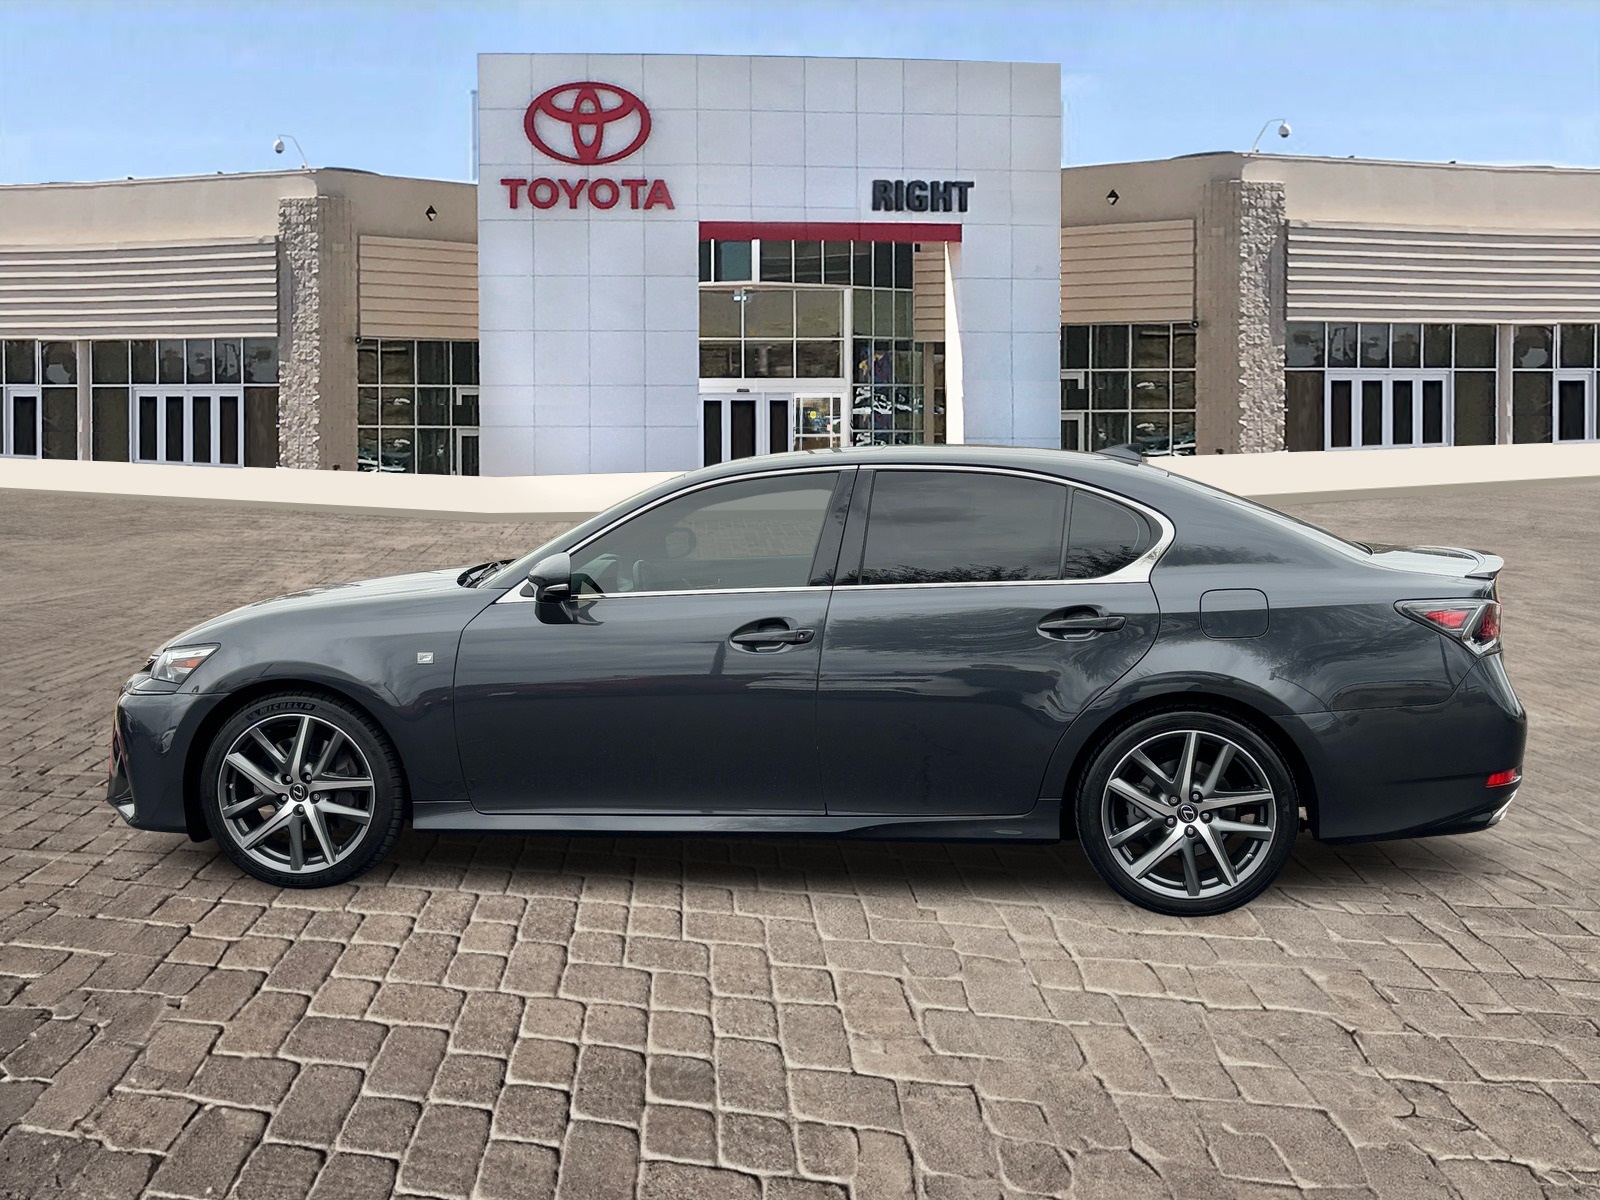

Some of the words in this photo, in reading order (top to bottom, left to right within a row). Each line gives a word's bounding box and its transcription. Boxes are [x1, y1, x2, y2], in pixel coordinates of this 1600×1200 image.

[500, 177, 676, 210] TOYOTA
[871, 179, 975, 213] RIGHT
[260, 701, 313, 714] MICHELIN
